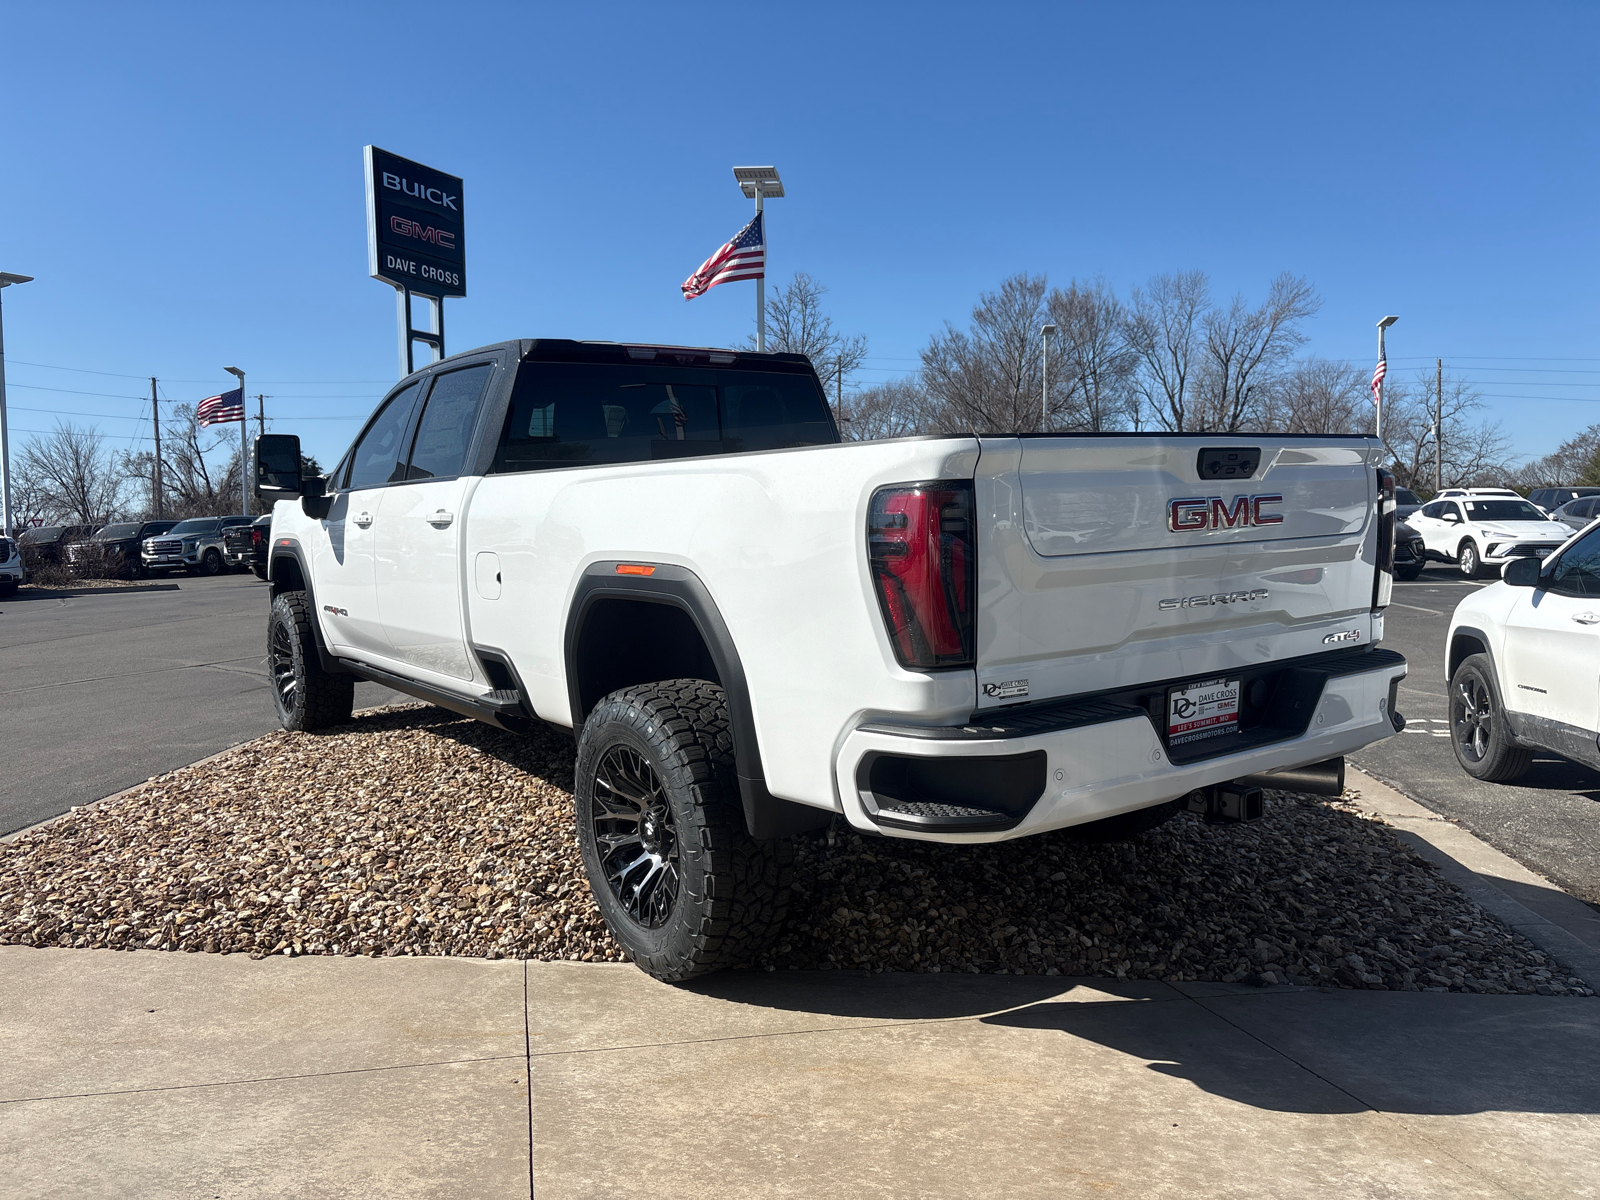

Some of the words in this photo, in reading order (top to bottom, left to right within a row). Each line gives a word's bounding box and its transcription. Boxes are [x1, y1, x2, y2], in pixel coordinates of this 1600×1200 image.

[382, 171, 458, 211] BUICK
[391, 215, 455, 249] GMC
[387, 255, 417, 275] DAVE
[421, 265, 460, 286] CROSS
[1167, 493, 1284, 533] GMC
[1158, 588, 1269, 612] SIERRA
[1322, 629, 1361, 645] AT4
[1198, 692, 1215, 703] DAVE
[1216, 688, 1237, 699] CROSS
[1217, 700, 1236, 709] GMC
[1170, 725, 1238, 746] DAVECROSSMOTORS.COM
[1177, 722, 1193, 732] LEE'S
[1193, 717, 1218, 728] SUMMIT,
